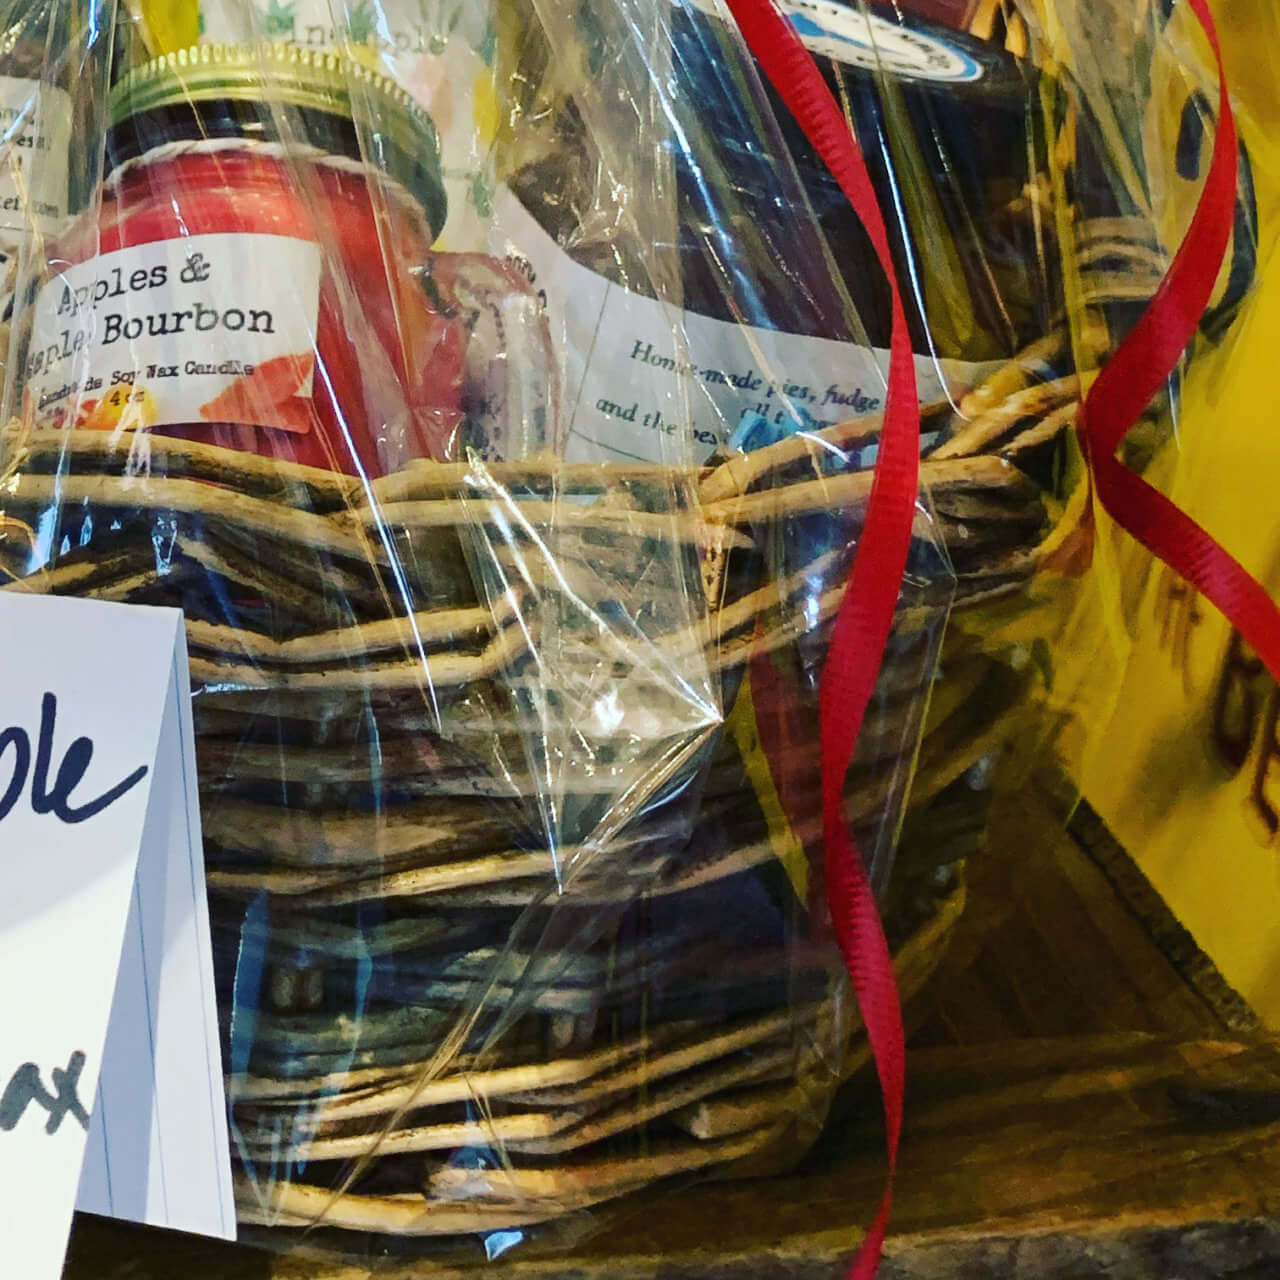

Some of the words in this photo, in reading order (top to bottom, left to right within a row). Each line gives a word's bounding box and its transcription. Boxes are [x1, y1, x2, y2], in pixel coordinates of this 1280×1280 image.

[56, 263, 168, 318] Apples
[179, 252, 211, 284] &
[26, 328, 86, 382] aple
[101, 302, 276, 346] Bourbon
[109, 390, 121, 407] 4
[595, 398, 639, 423] and
[643, 410, 678, 436] the
[821, 383, 880, 413] fudge
